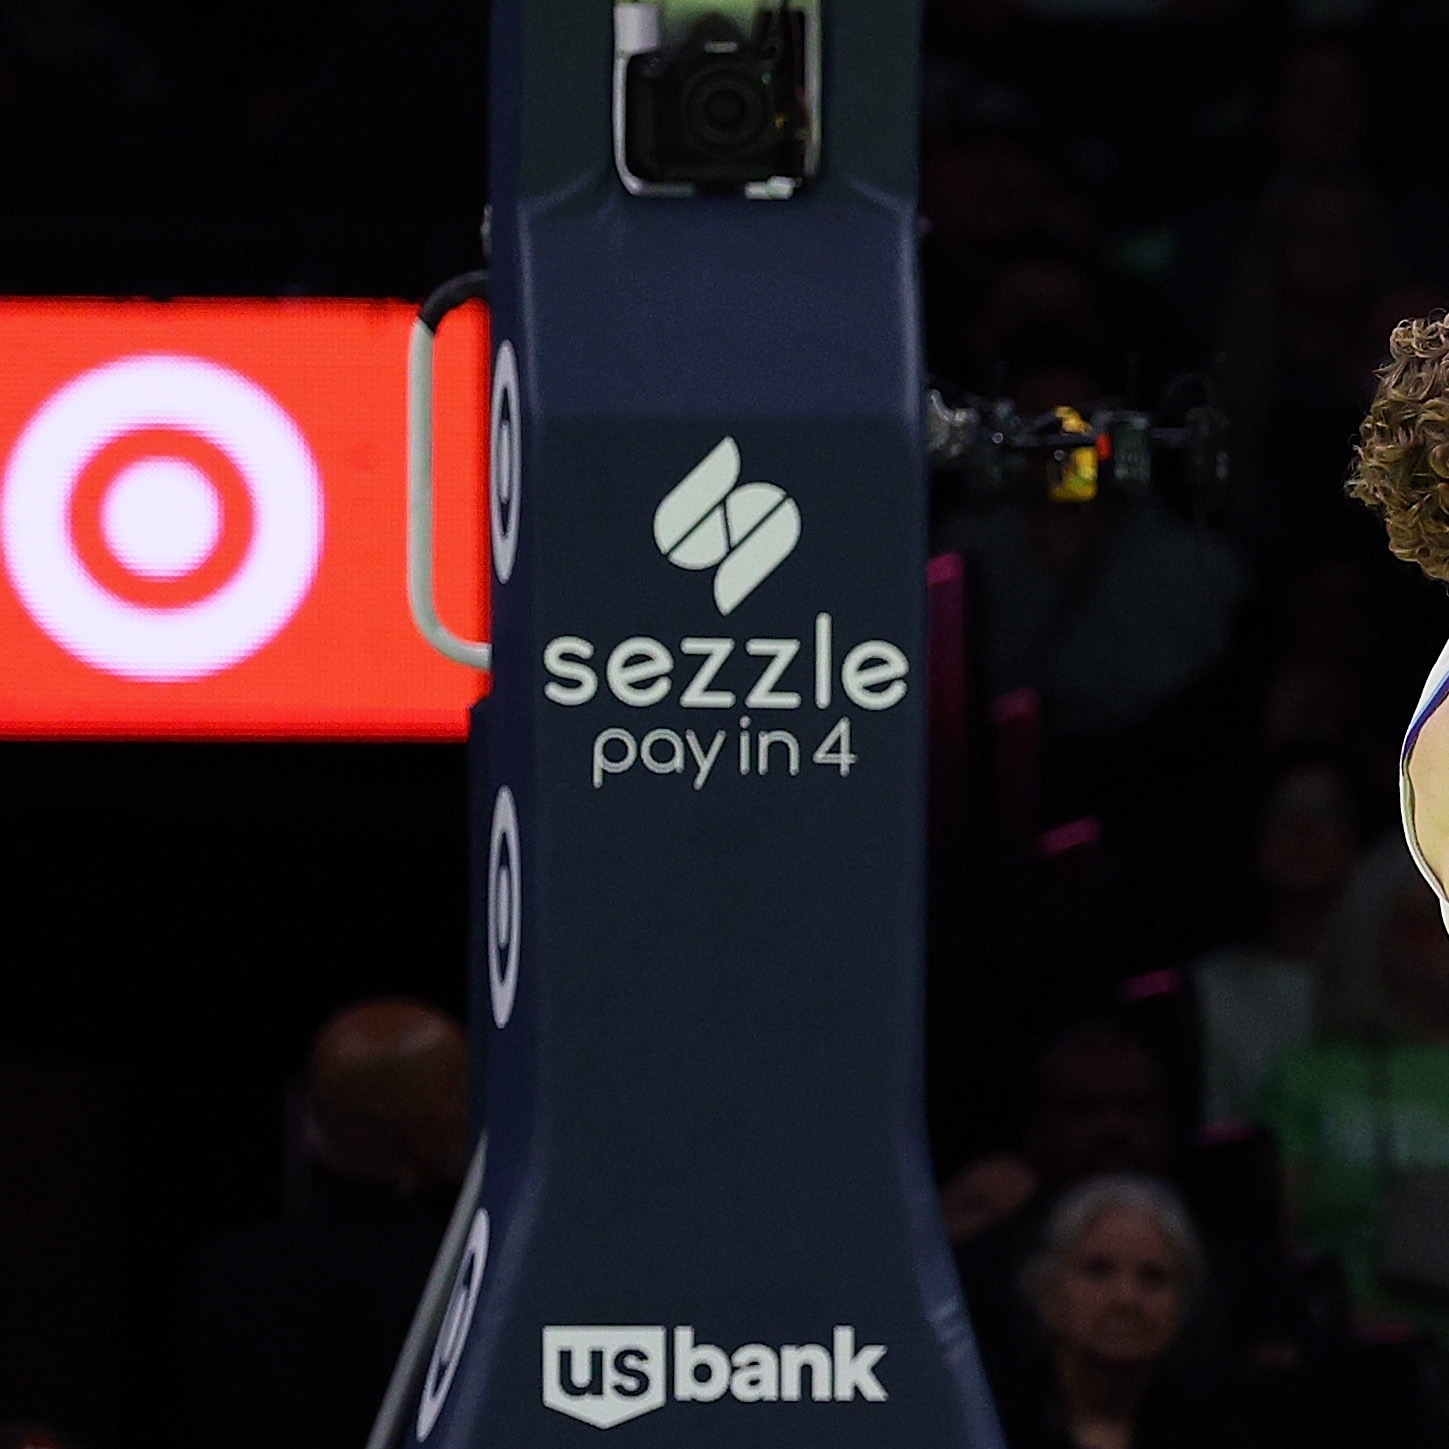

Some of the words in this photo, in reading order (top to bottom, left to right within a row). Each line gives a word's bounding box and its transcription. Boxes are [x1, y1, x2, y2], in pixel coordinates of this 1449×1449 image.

[543, 611, 910, 711] sezzle
[592, 727, 727, 790] pay
[739, 716, 800, 776] in
[813, 716, 858, 777] 4
[673, 1325, 889, 1402] bank
